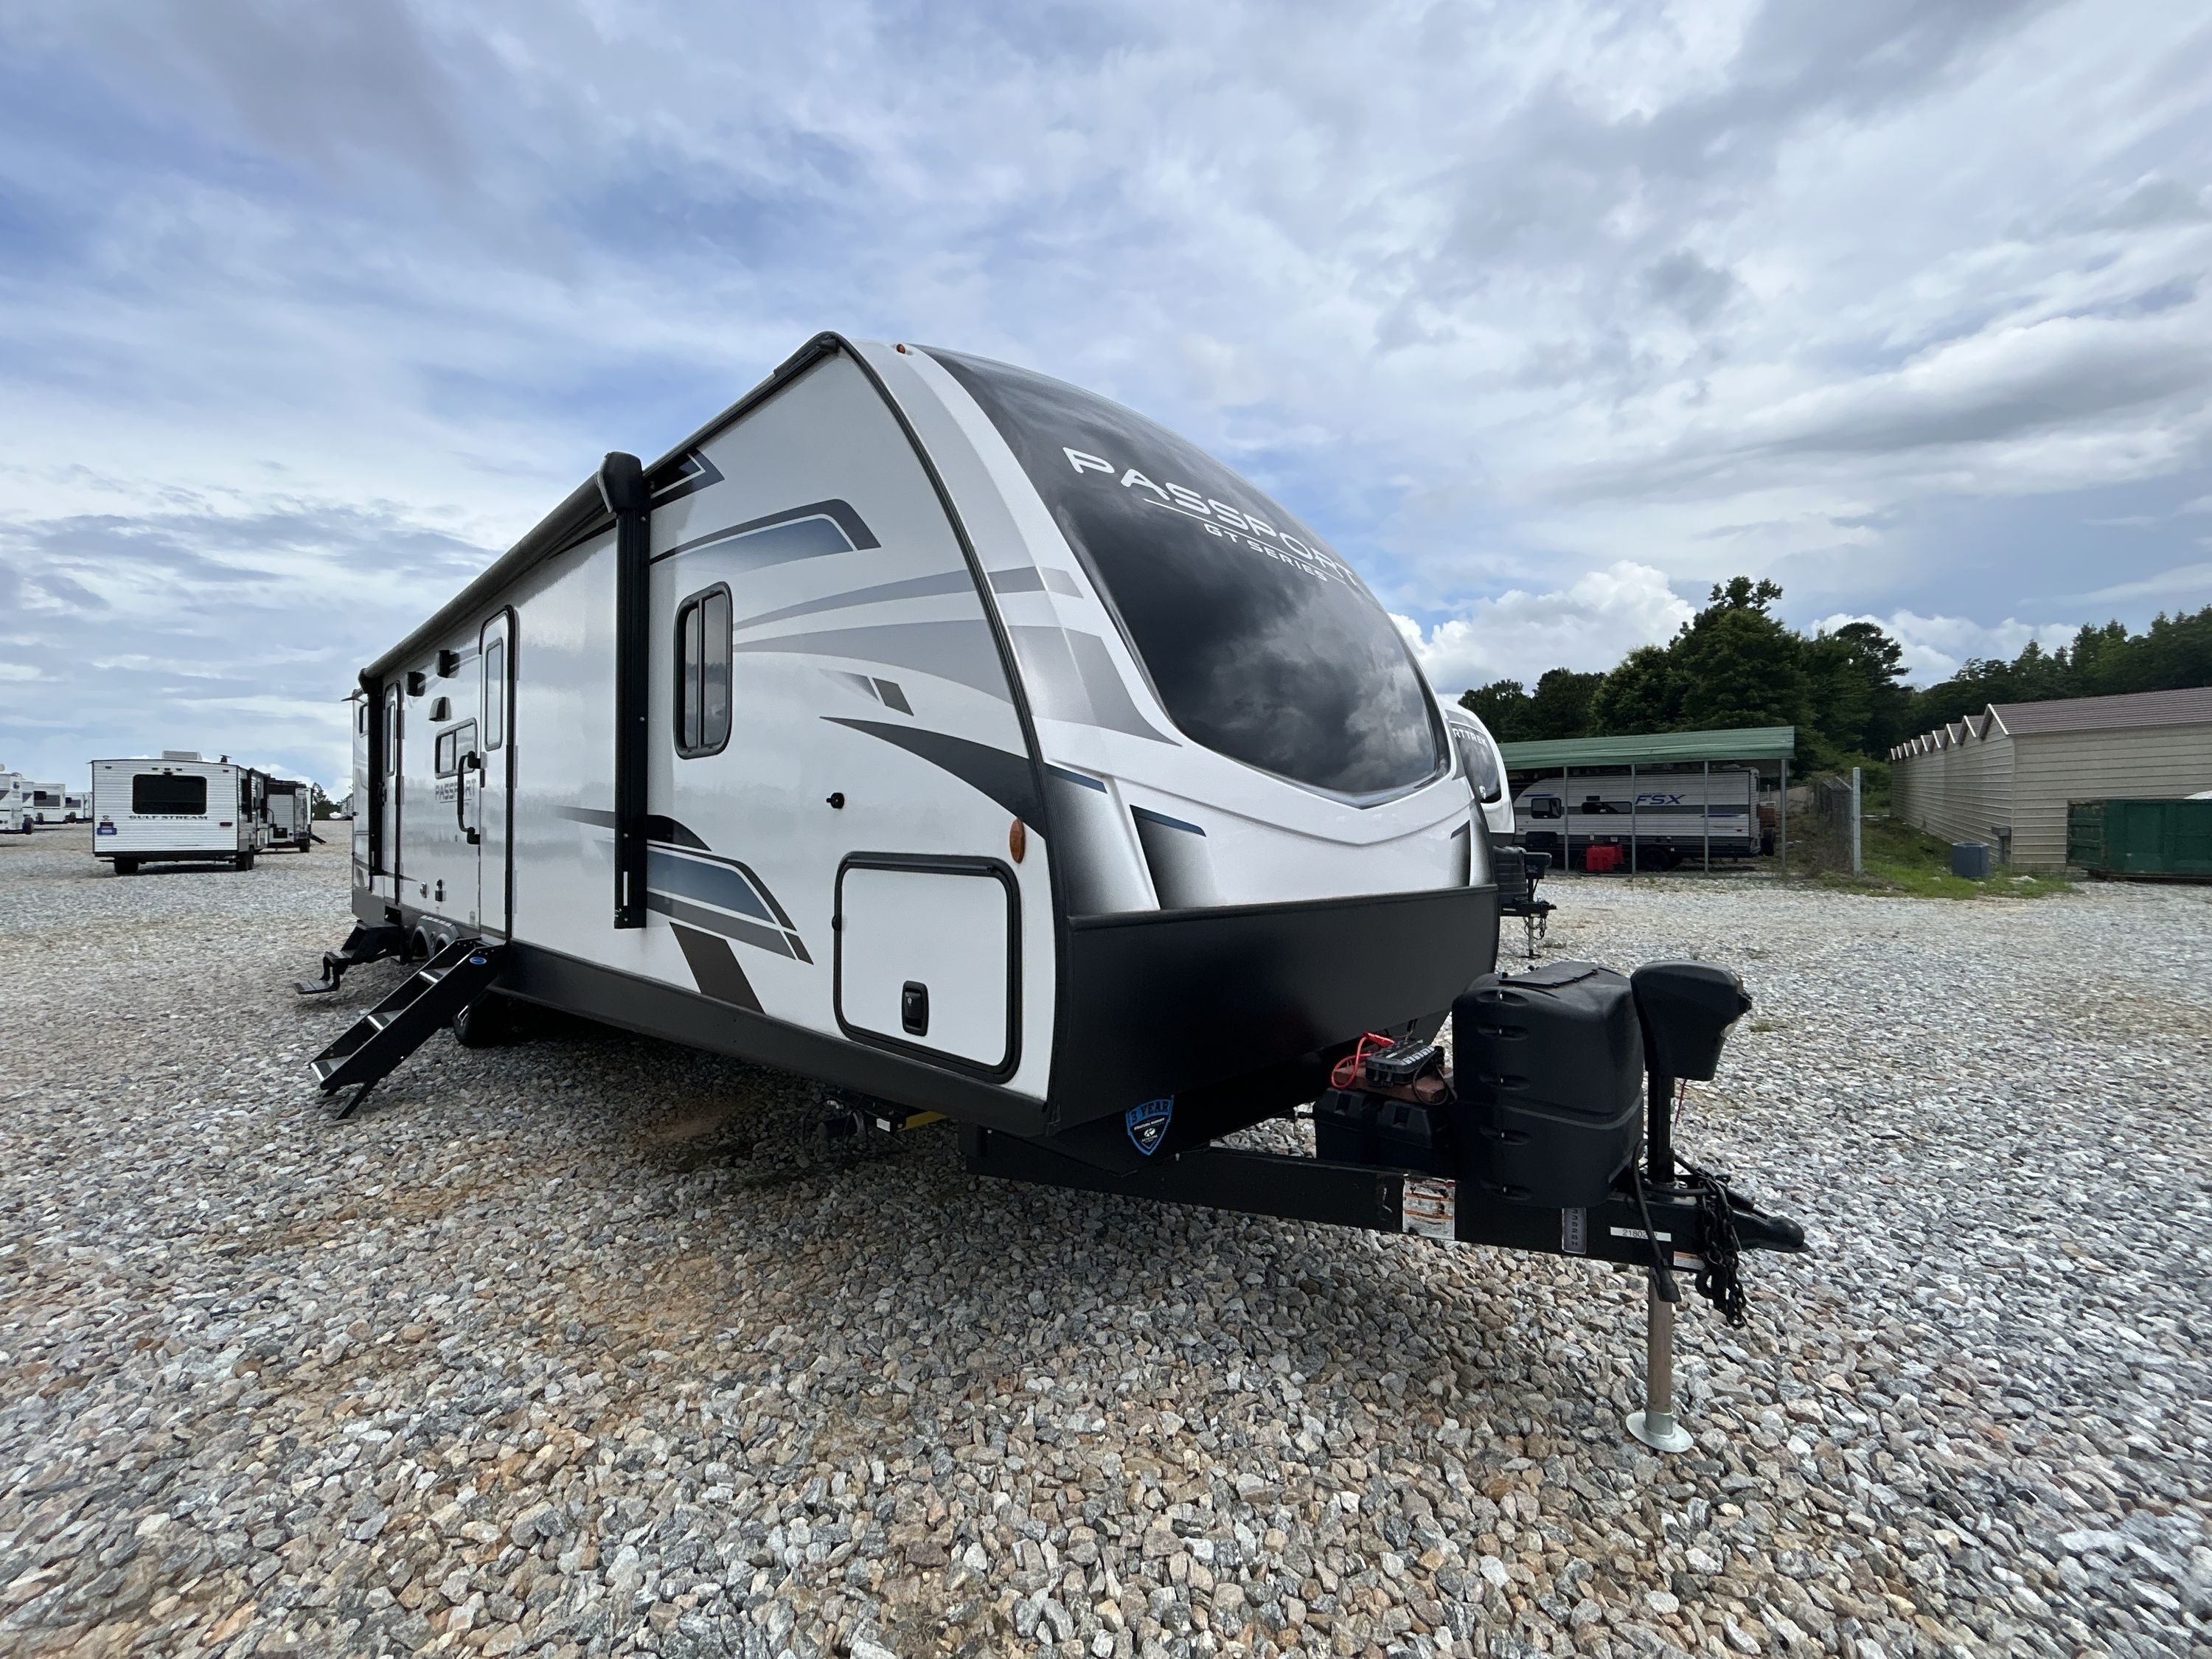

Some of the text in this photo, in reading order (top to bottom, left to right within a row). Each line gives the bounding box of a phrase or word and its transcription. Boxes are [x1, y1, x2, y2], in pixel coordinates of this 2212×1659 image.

[1062, 447, 1357, 586] PASSPORT
[1203, 523, 1328, 582] GT SERIES
[435, 778, 476, 801] PASSPRT
[1635, 794, 1686, 804] FSX
[1140, 1099, 1170, 1118] YEAR
